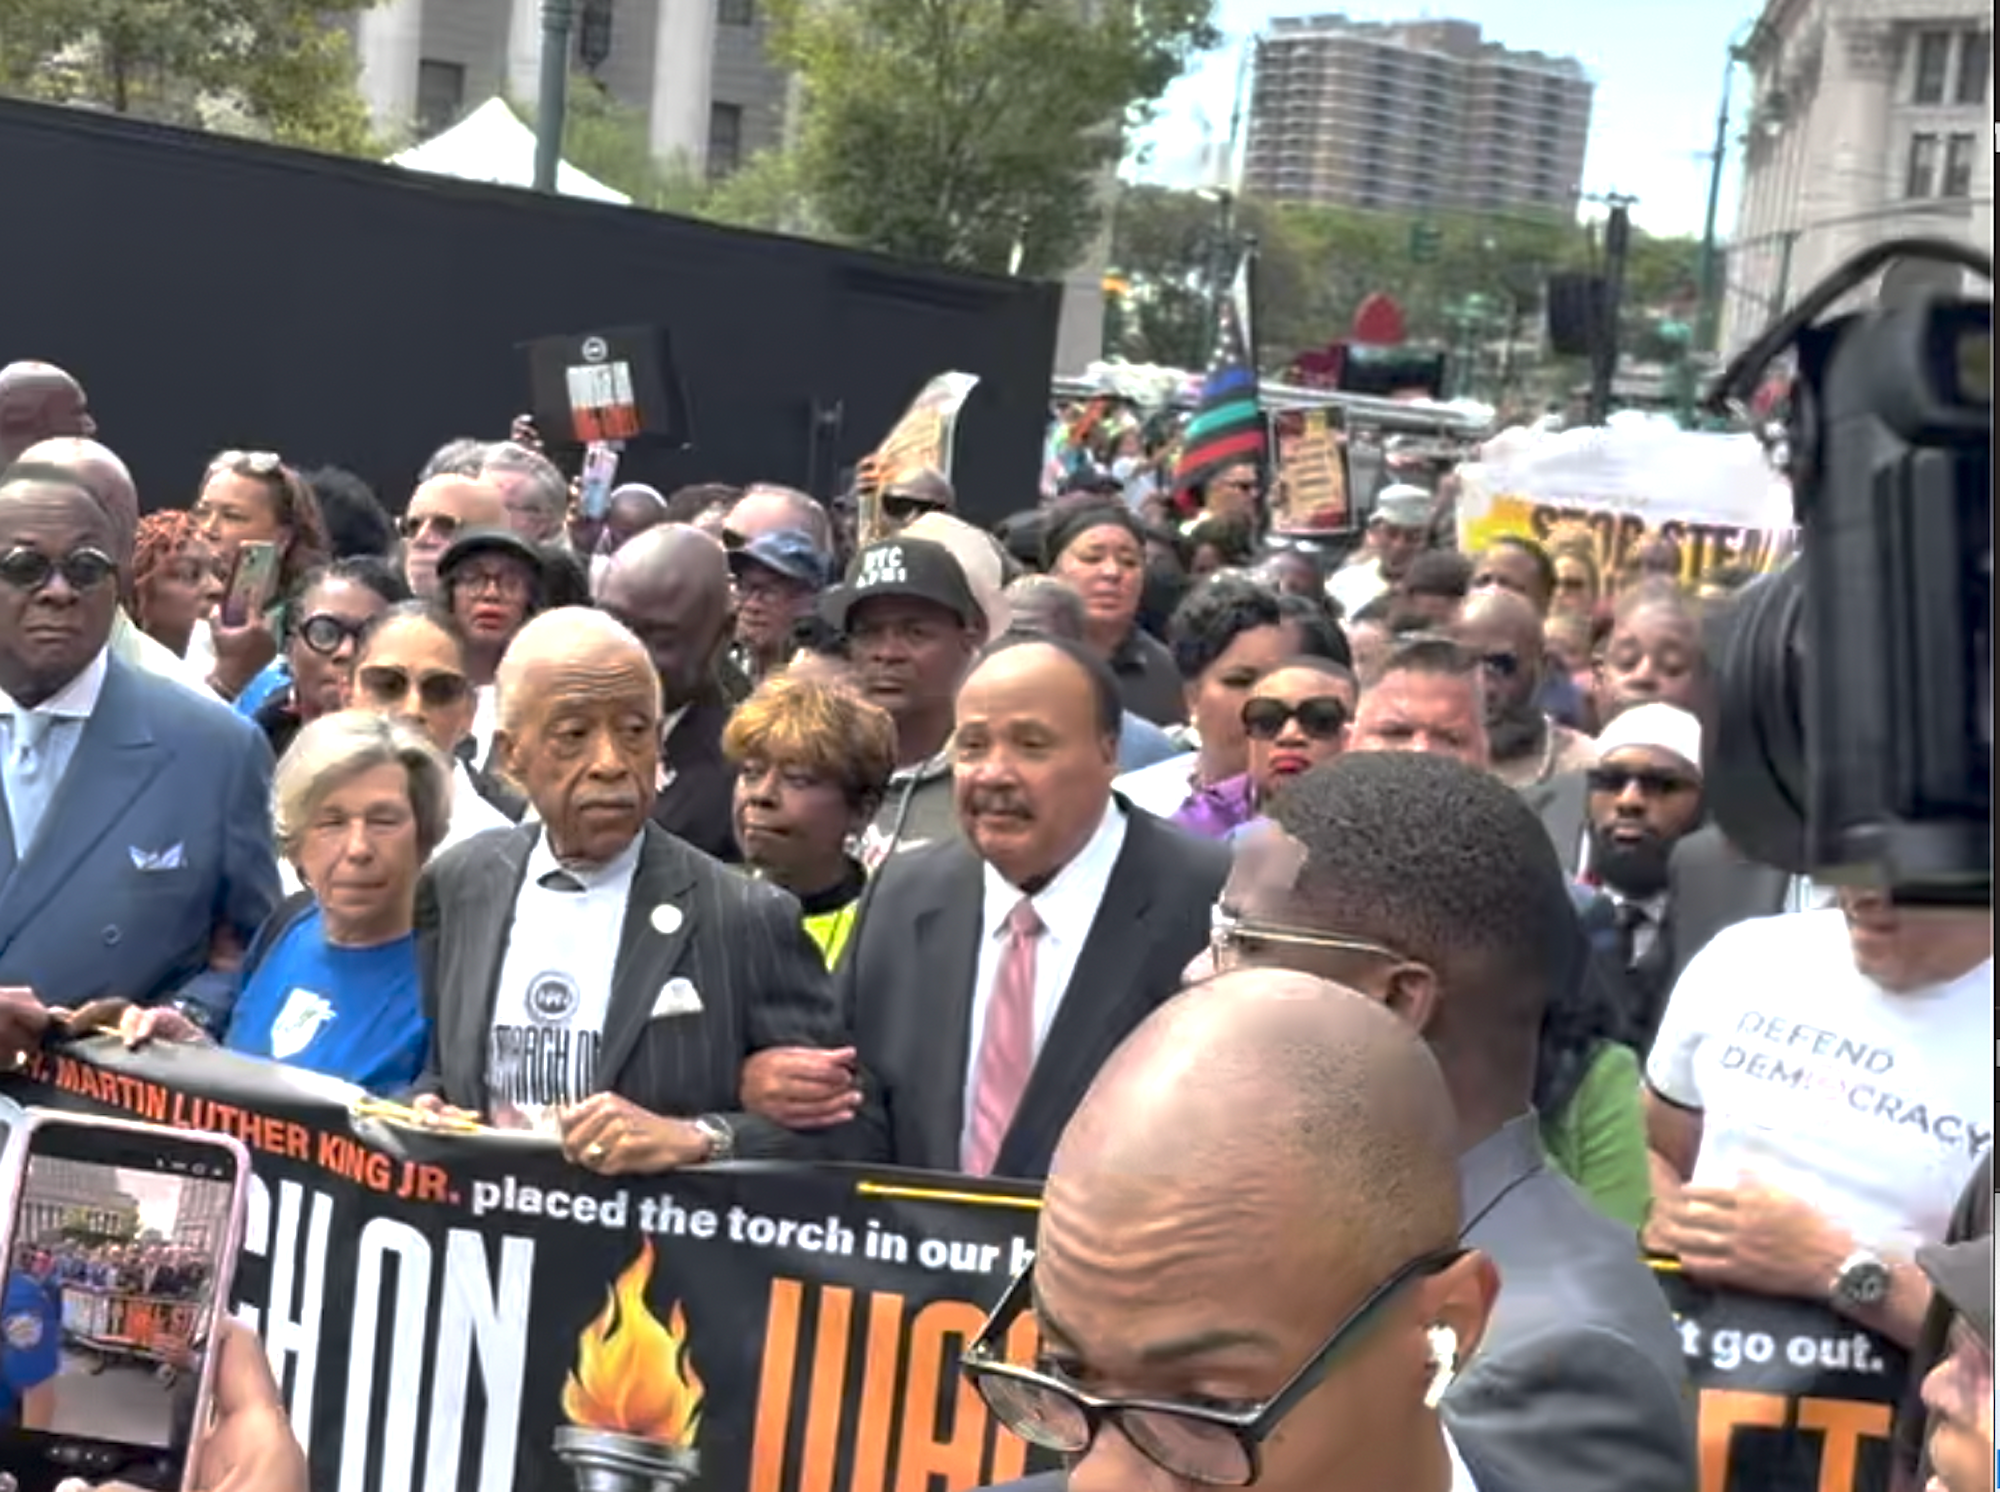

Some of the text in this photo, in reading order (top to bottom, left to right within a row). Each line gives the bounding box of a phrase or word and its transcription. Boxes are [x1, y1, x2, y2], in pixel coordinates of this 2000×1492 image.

[1736, 1009, 1895, 1076] DEFEND
[55, 1055, 168, 1121] MARTIN
[172, 1092, 310, 1162] LUTHER
[317, 1130, 392, 1192] KING
[396, 1159, 462, 1205] JR.
[472, 1174, 629, 1228] placed
[638, 1193, 718, 1238] the
[726, 1205, 855, 1255] torch
[864, 1217, 908, 1263] in
[917, 1237, 1001, 1273] our
[1711, 1329, 1775, 1371] go
[1785, 1332, 1885, 1373] out.
[338, 1216, 536, 1492] ON
